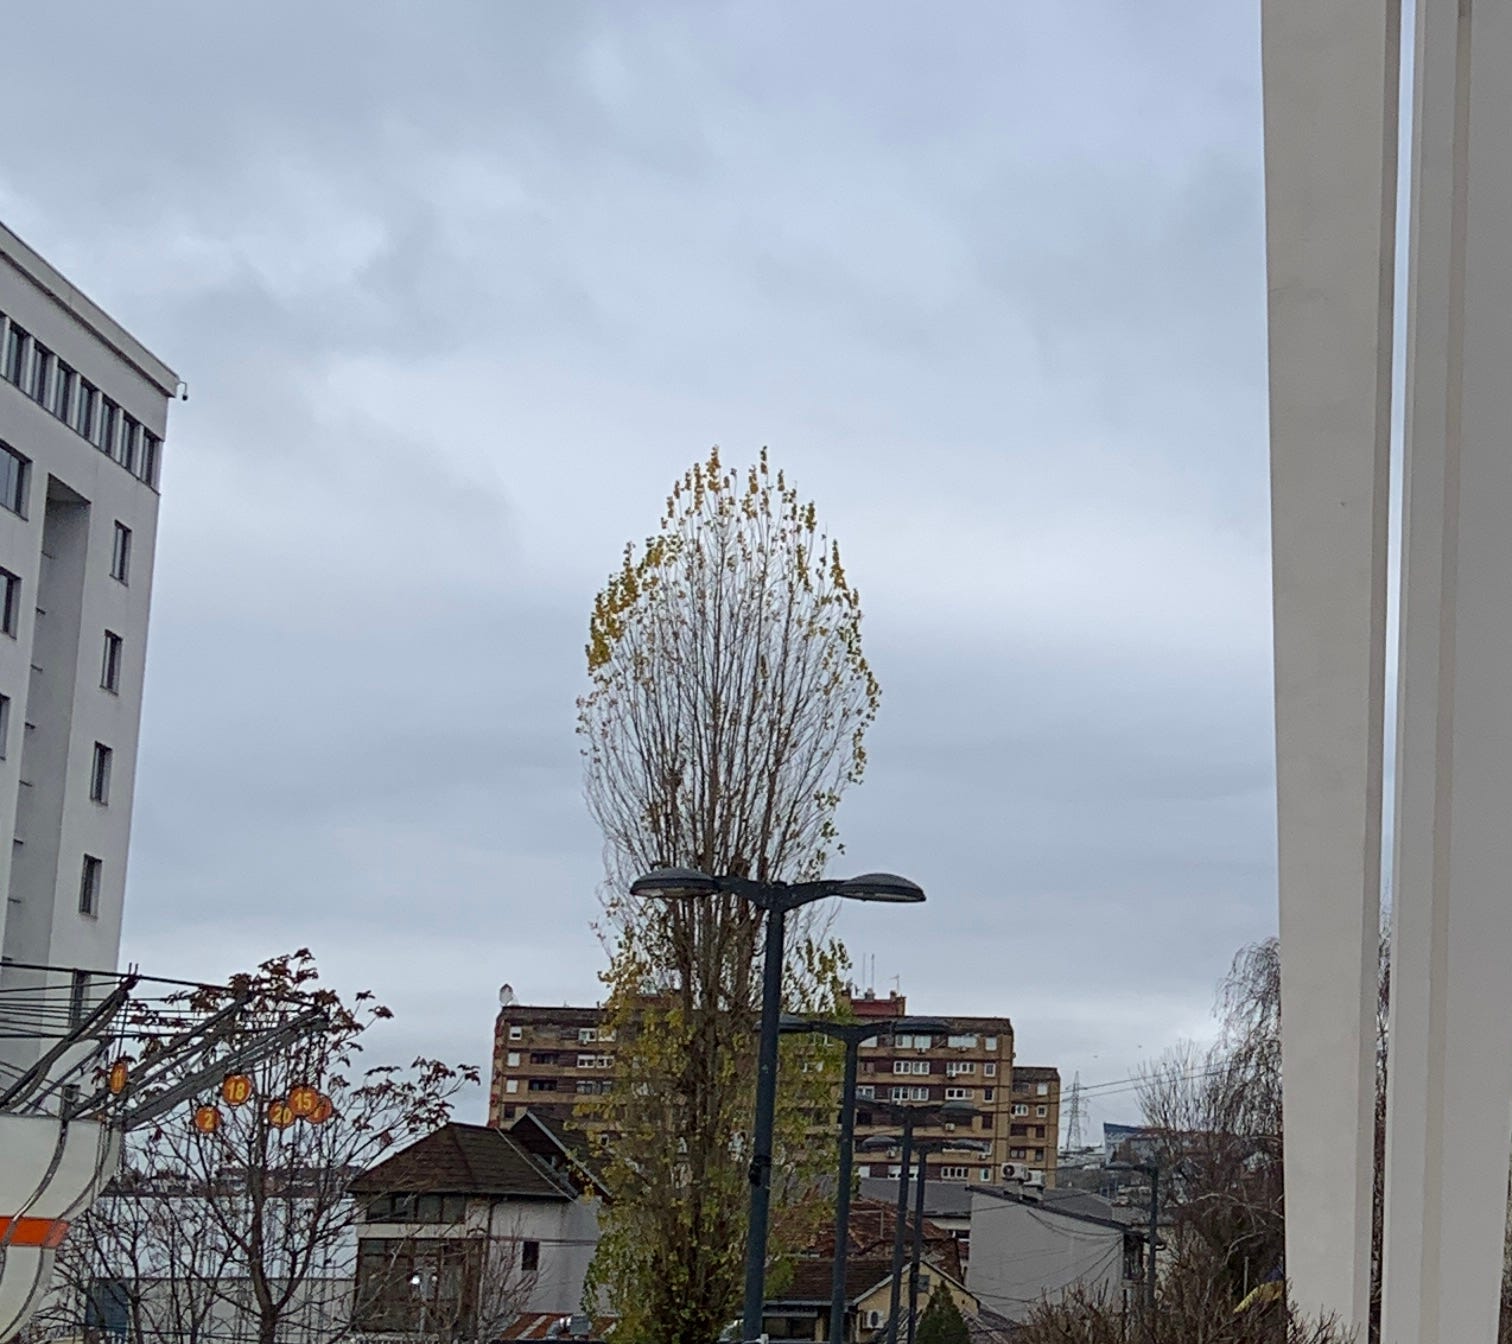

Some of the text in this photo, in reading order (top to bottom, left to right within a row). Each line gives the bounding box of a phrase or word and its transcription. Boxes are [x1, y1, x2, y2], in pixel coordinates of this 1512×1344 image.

[227, 1081, 246, 1100] 18
[294, 1092, 312, 1110] 15
[204, 1112, 215, 1129] 2
[271, 1106, 293, 1125] 20
